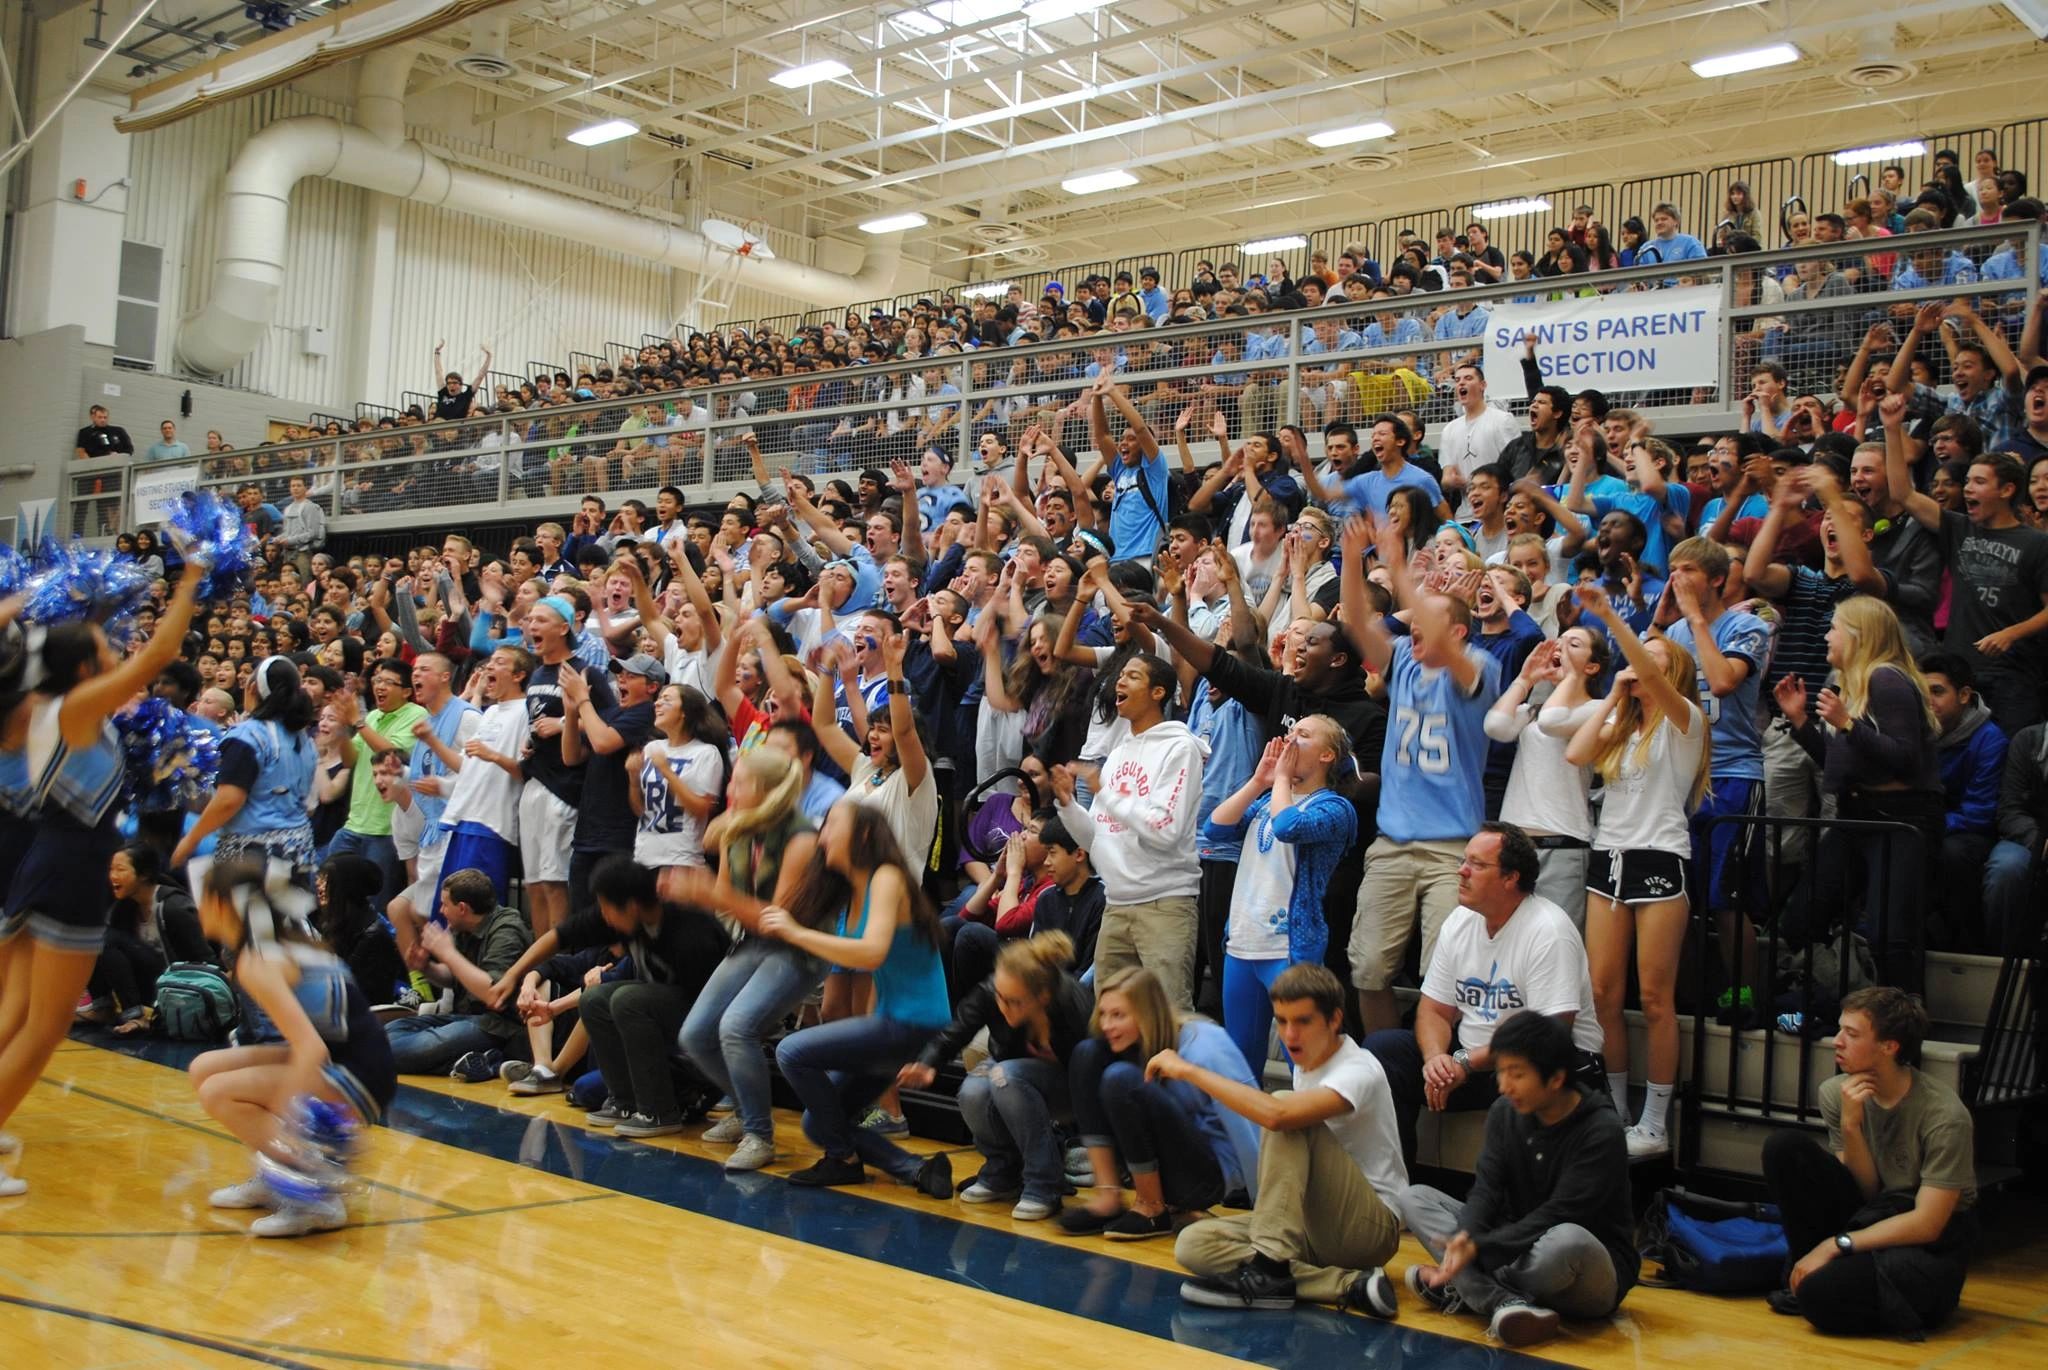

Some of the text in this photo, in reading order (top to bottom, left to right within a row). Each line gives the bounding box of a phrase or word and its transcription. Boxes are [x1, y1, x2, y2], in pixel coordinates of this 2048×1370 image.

[1597, 310, 1706, 340] PARENT
[1539, 348, 1656, 377] SECTION
[1960, 536, 2020, 564] BROOKLYN
[1977, 586, 2001, 607] 75
[1395, 703, 1452, 776] 75
